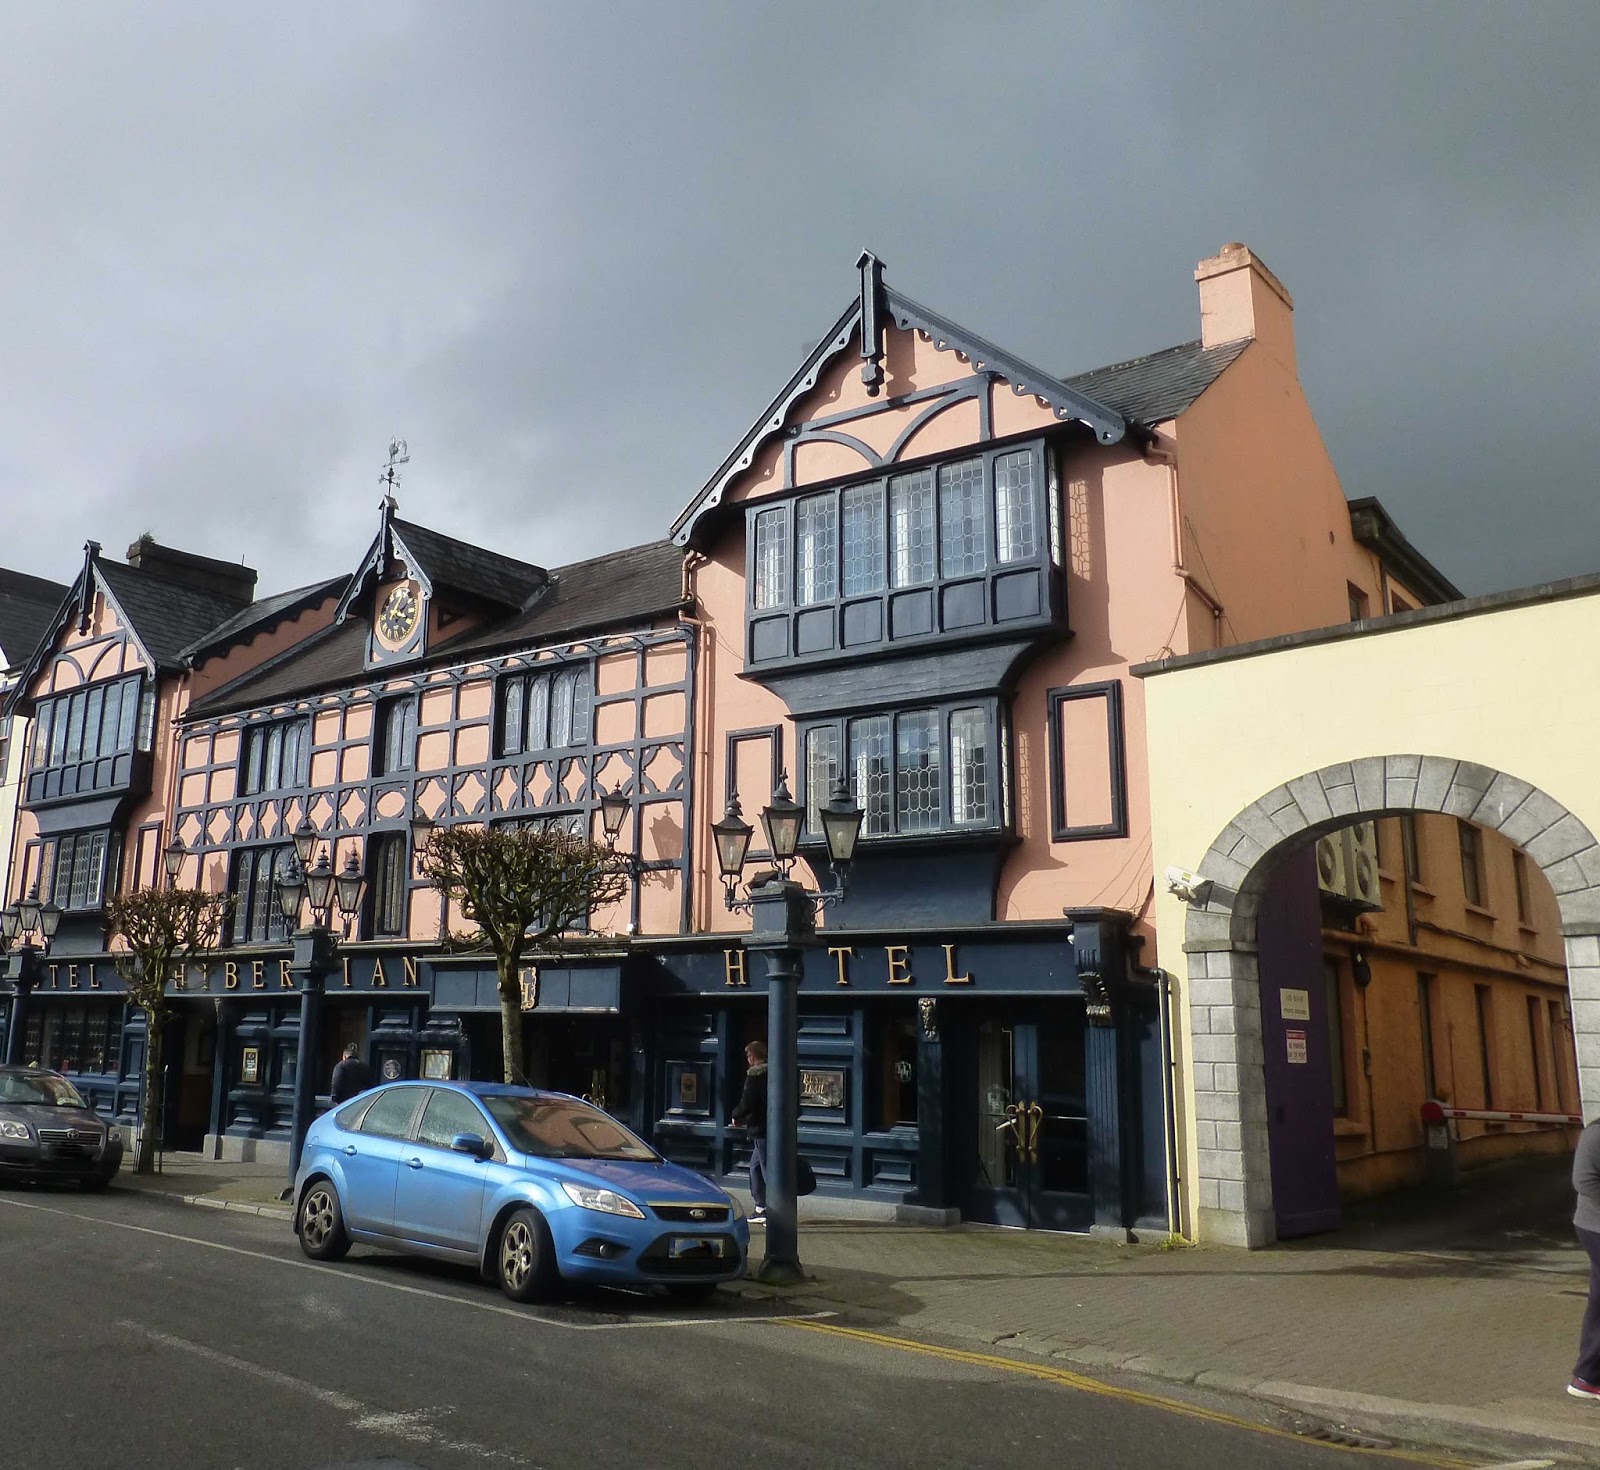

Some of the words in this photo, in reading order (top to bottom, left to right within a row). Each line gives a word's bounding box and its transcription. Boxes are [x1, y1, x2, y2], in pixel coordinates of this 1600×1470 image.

[33, 963, 99, 988] TEL
[174, 956, 417, 990] HIBERIAN
[723, 944, 970, 985] HTEL
